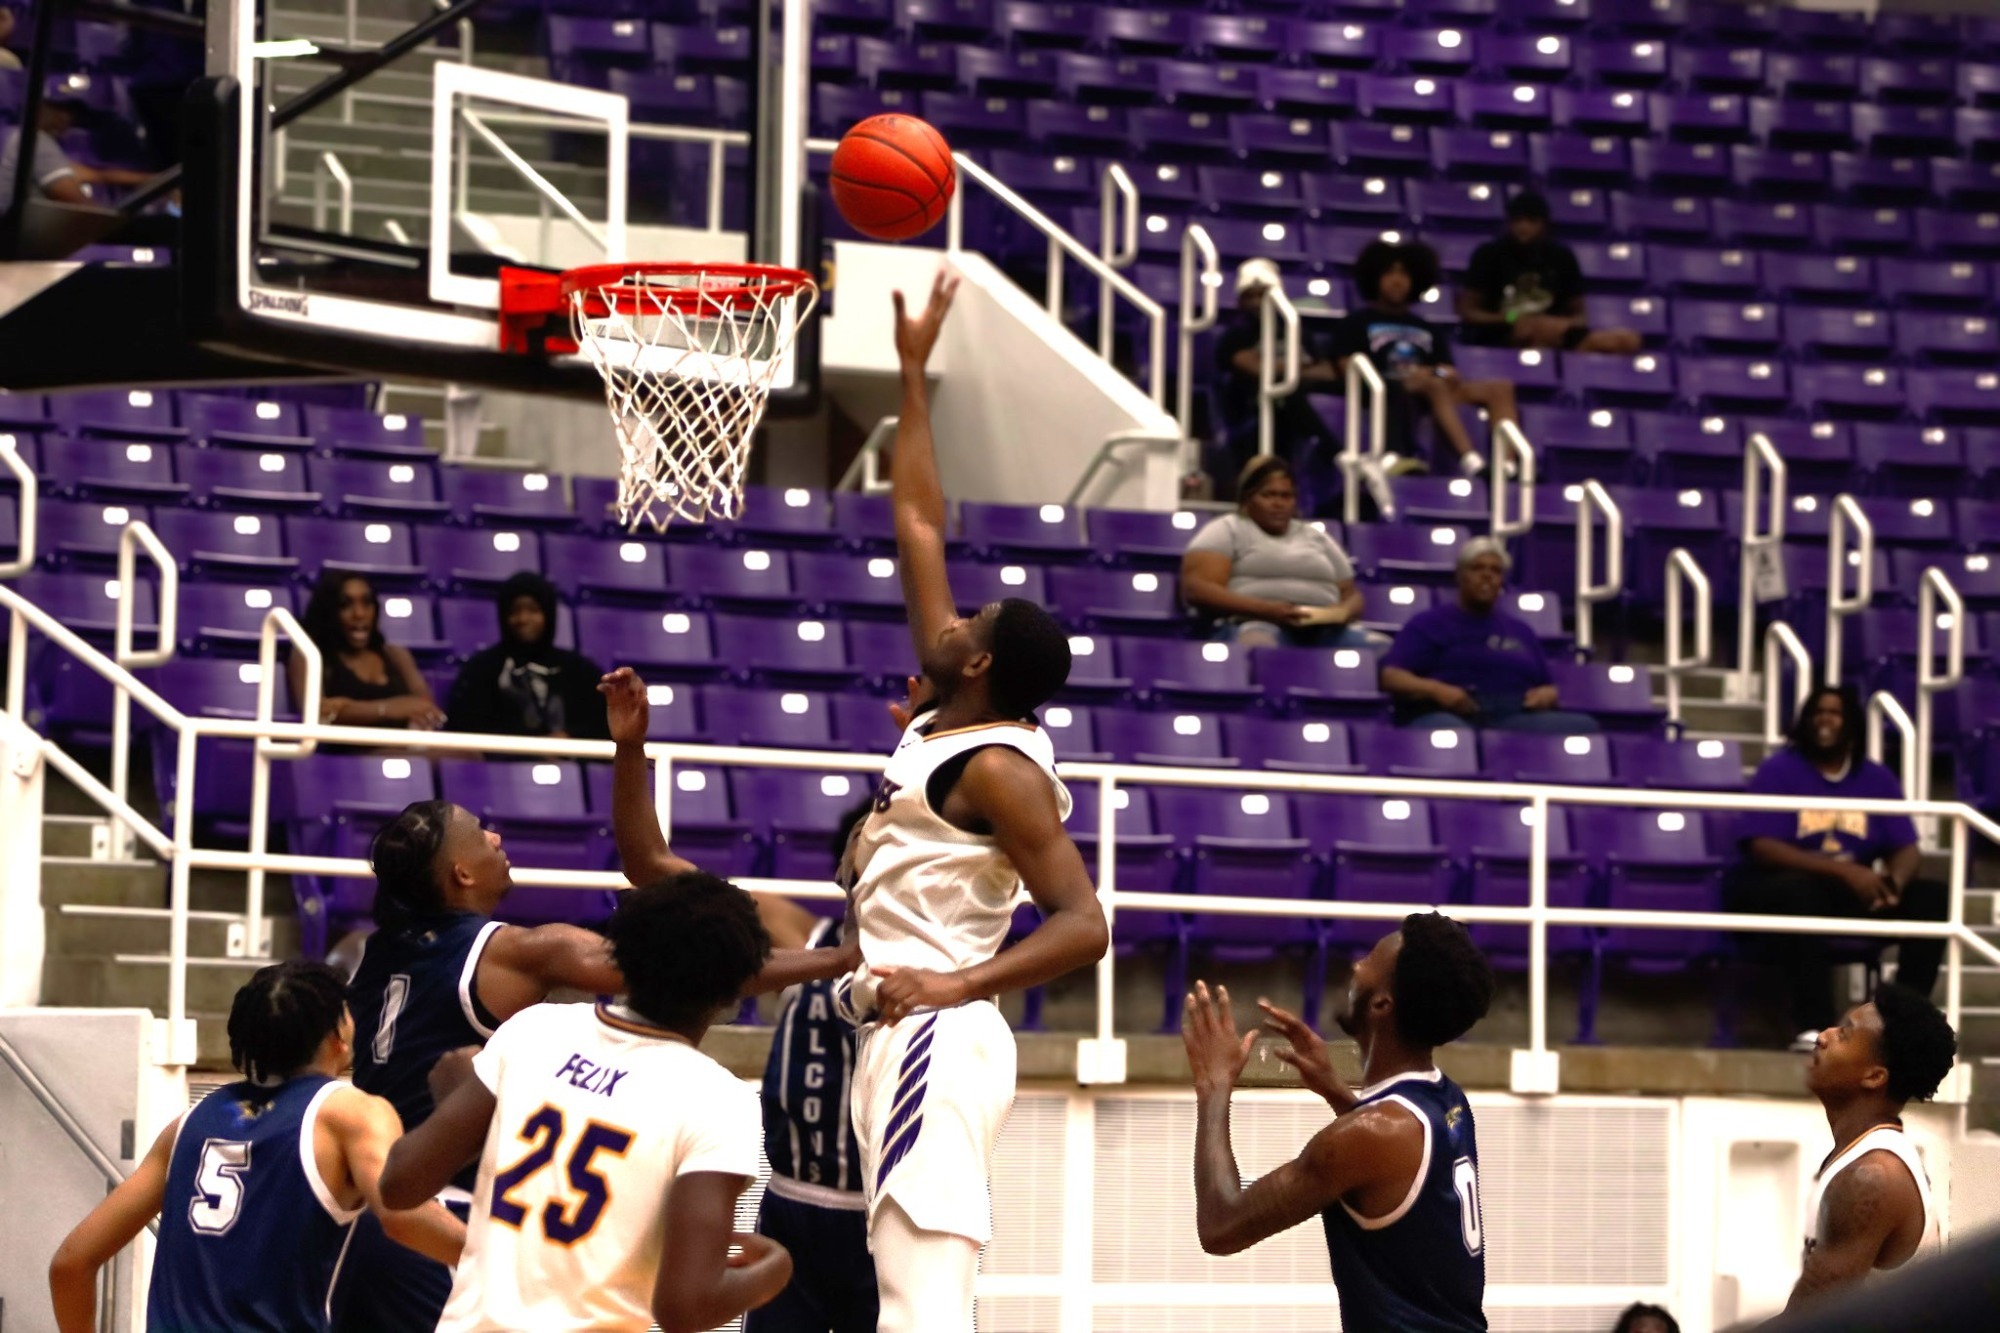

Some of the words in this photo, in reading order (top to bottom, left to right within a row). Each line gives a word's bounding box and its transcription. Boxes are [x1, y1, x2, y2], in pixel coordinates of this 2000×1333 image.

[372, 974, 411, 1064] 1
[555, 1053, 629, 1097] FELIX
[803, 979, 829, 1183] ALCONS
[188, 1138, 252, 1237] 5
[489, 1101, 638, 1249] 25
[1453, 1155, 1482, 1258] 0
